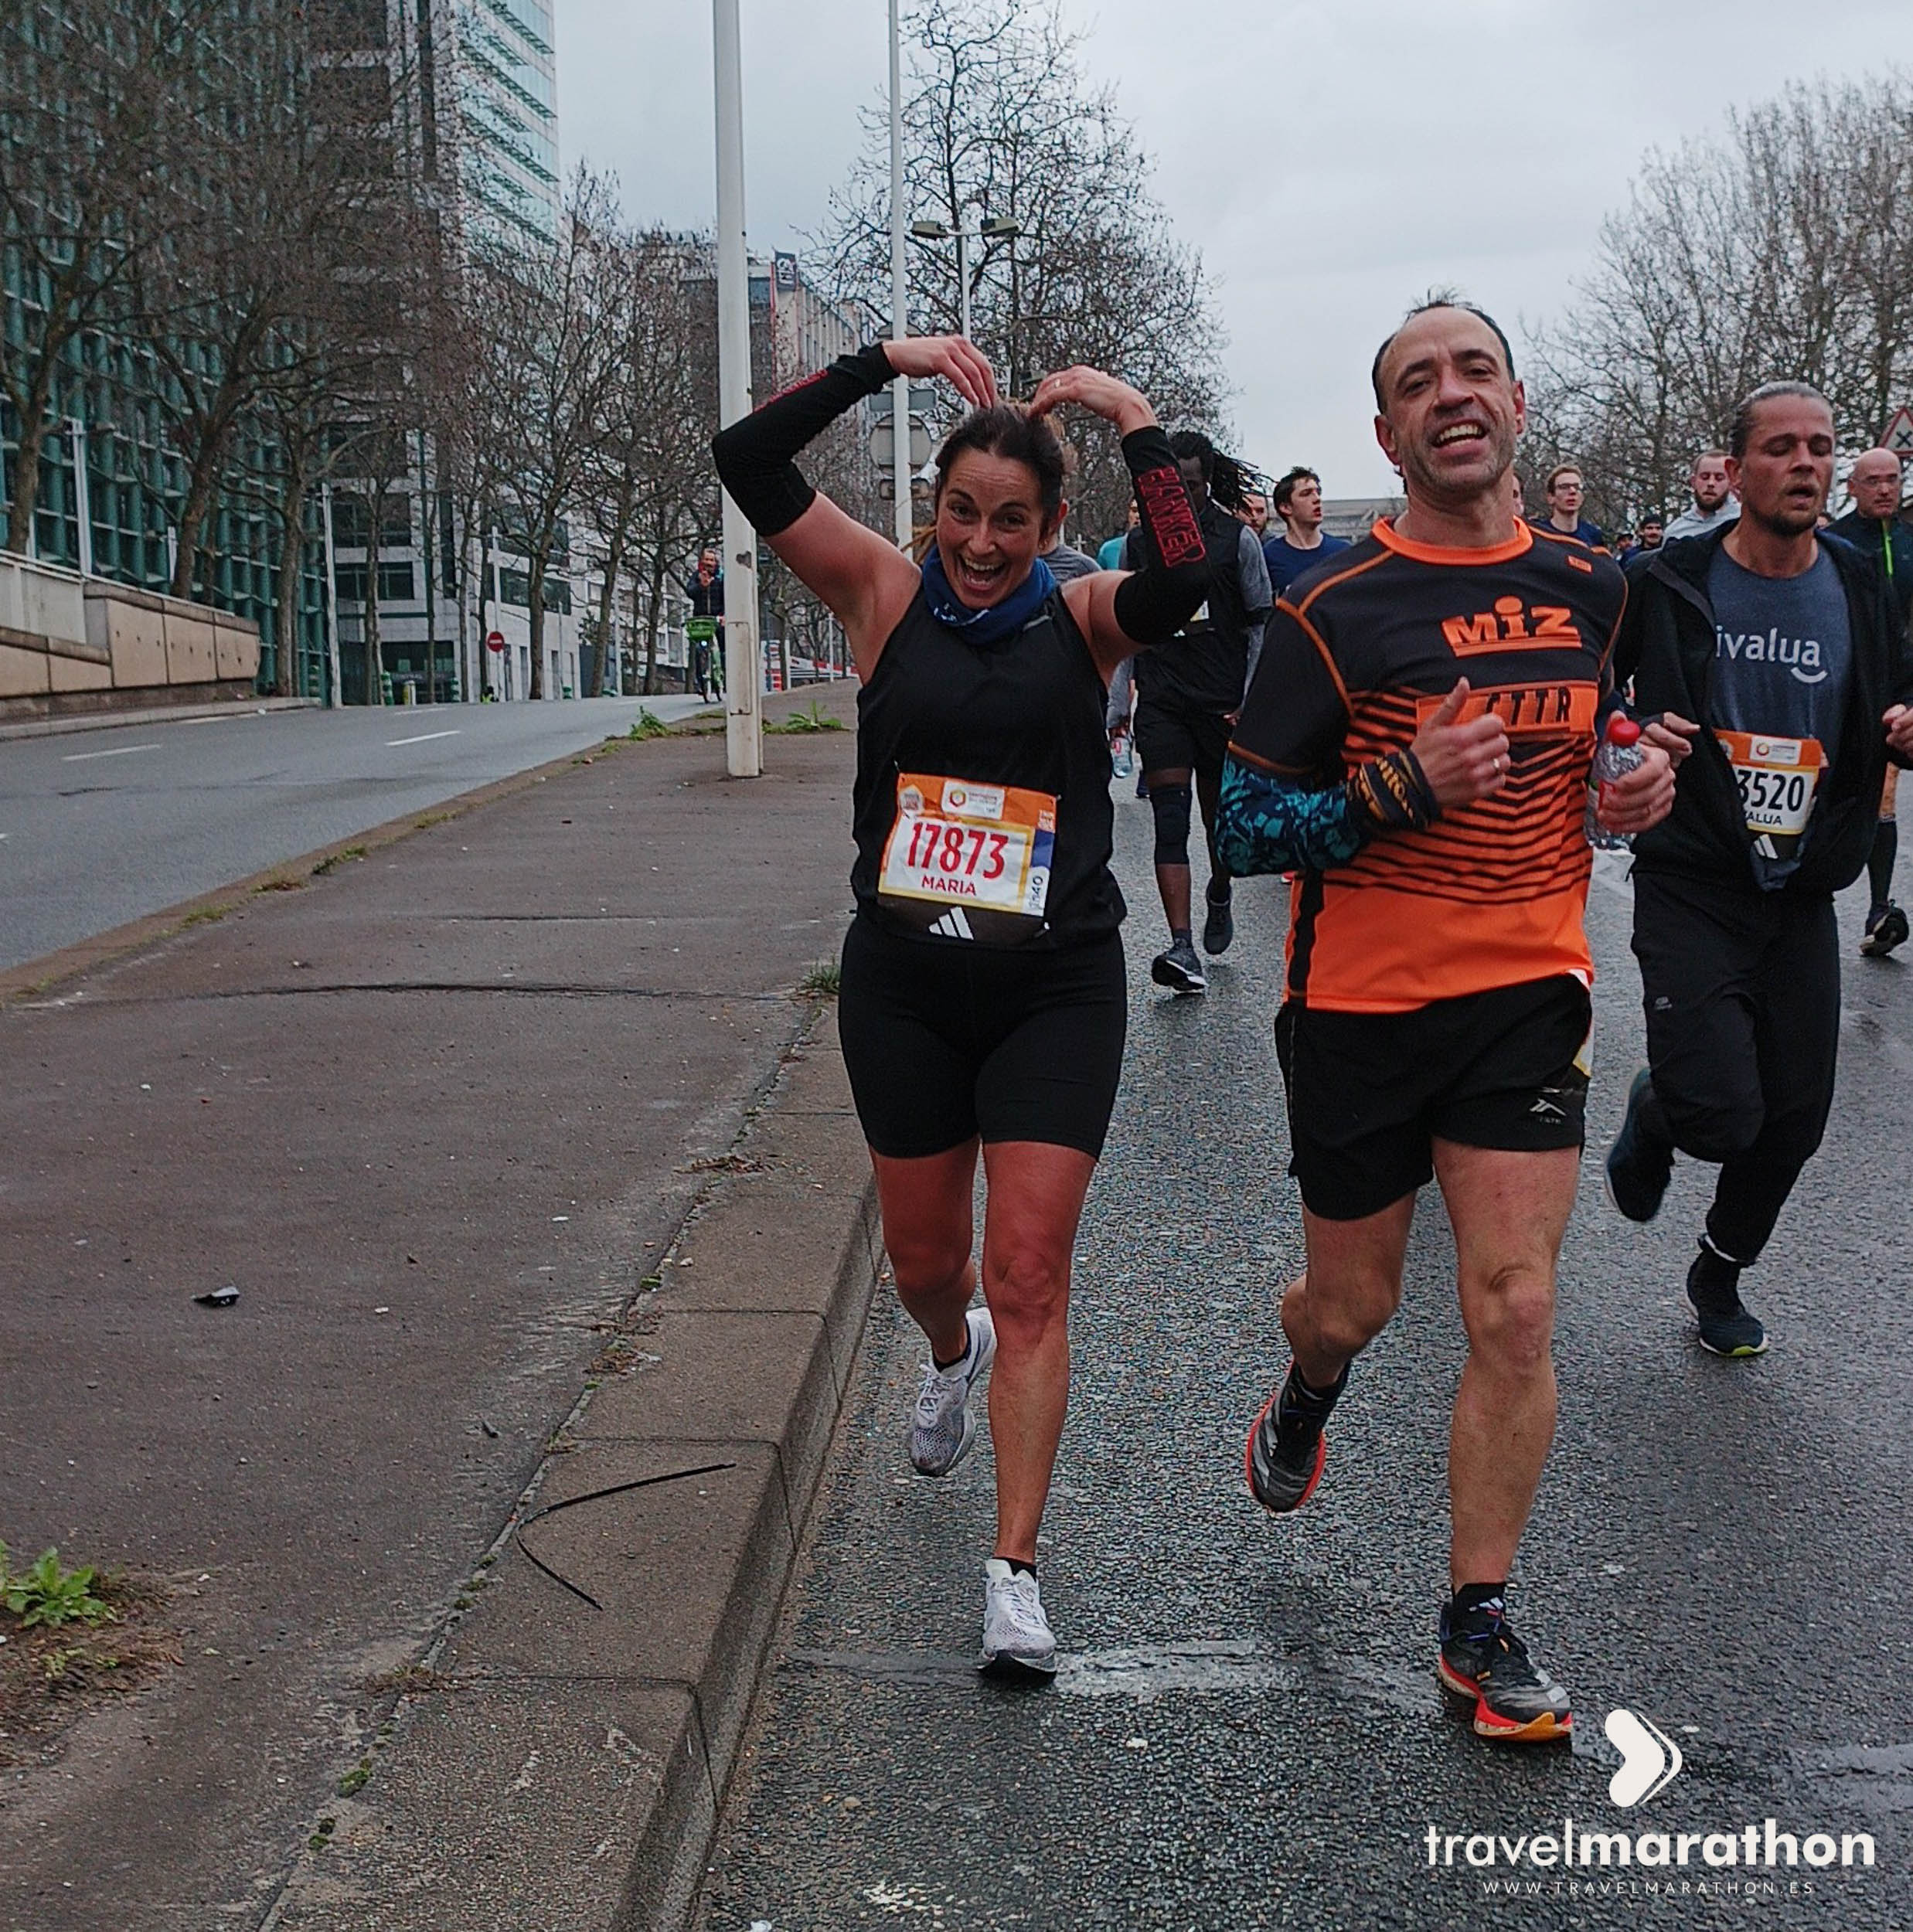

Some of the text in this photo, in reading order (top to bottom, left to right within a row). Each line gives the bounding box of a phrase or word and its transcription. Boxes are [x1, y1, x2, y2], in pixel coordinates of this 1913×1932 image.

[1715, 624, 1821, 668] ivalua
[907, 821, 1009, 879] 17873
[921, 874, 976, 896] MARIA
